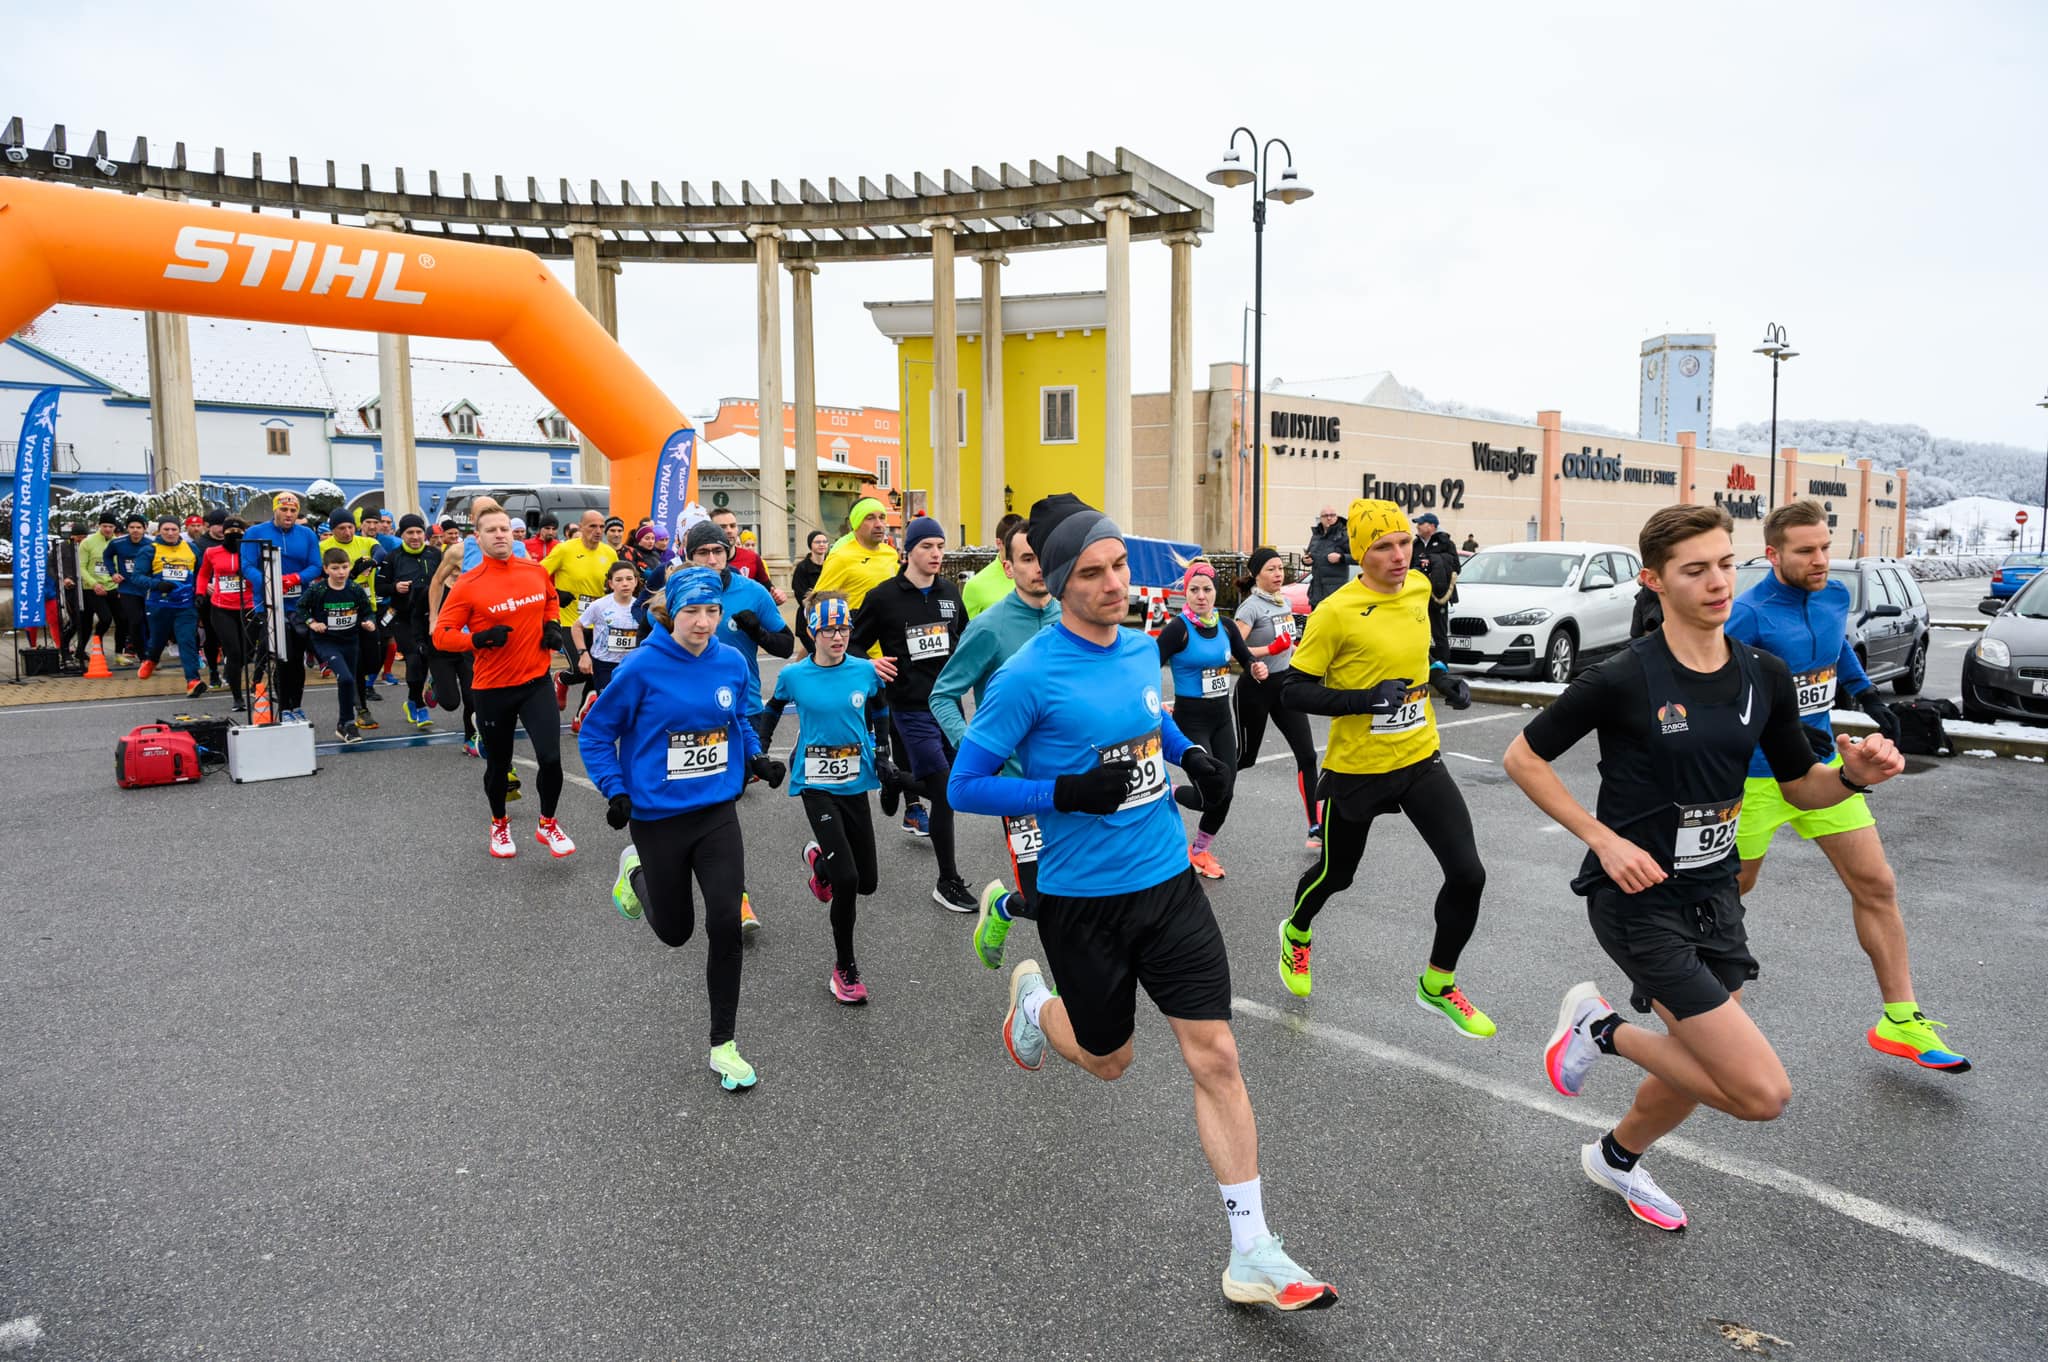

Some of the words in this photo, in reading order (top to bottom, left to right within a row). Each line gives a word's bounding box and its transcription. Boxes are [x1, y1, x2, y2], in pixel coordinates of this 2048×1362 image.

[163, 226, 427, 305] STIHL
[1271, 411, 1340, 442] MUSTANG
[20, 434, 37, 506] KRAPINA
[1472, 441, 1537, 480] Wrangler
[1562, 446, 1621, 481] adidas
[657, 463, 672, 518] KRAPINA
[1363, 473, 1436, 514] Europa
[1441, 478, 1465, 509] 92
[20, 508, 31, 597] MARATON
[20, 600, 29, 623] TK
[616, 637, 632, 646] 861
[919, 636, 942, 650] 844
[1212, 677, 1226, 690] 858
[1799, 685, 1828, 705] 867
[683, 746, 717, 767] 266
[818, 759, 849, 775] 263
[1699, 820, 1737, 851] 923
